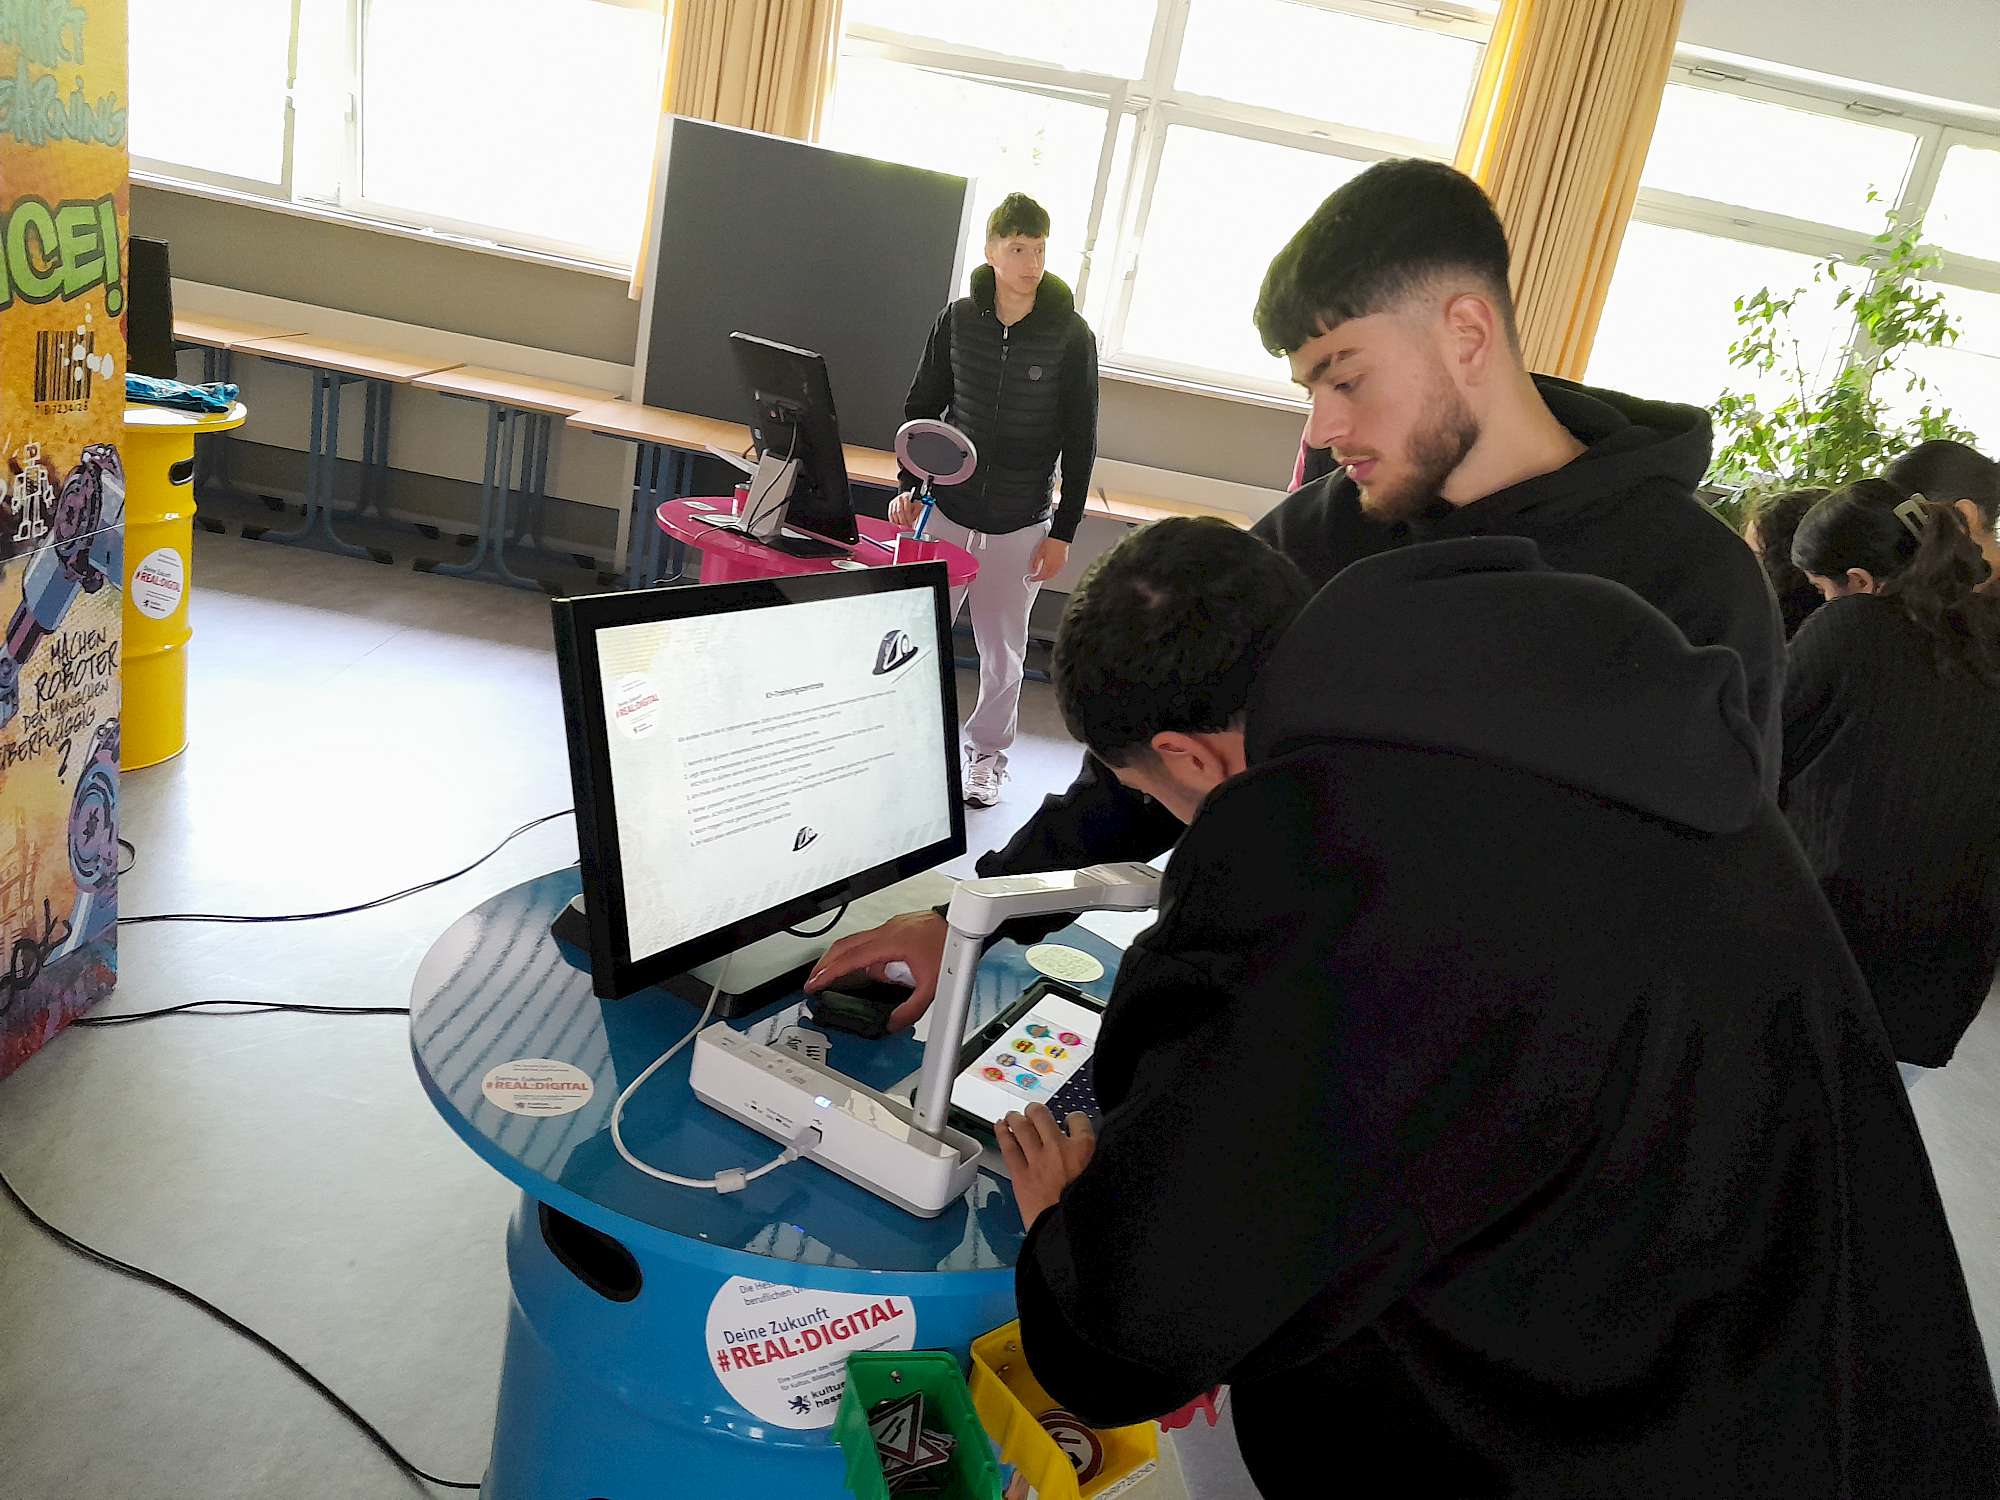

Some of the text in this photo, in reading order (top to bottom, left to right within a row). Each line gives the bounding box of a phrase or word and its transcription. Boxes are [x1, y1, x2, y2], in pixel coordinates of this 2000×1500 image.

[51, 627, 106, 666] MACHEN
[35, 640, 119, 710] ROBOTER
[717, 1298, 904, 1373] #REAL:DIGITAL
[724, 1307, 831, 1345] Deine Zukunft
